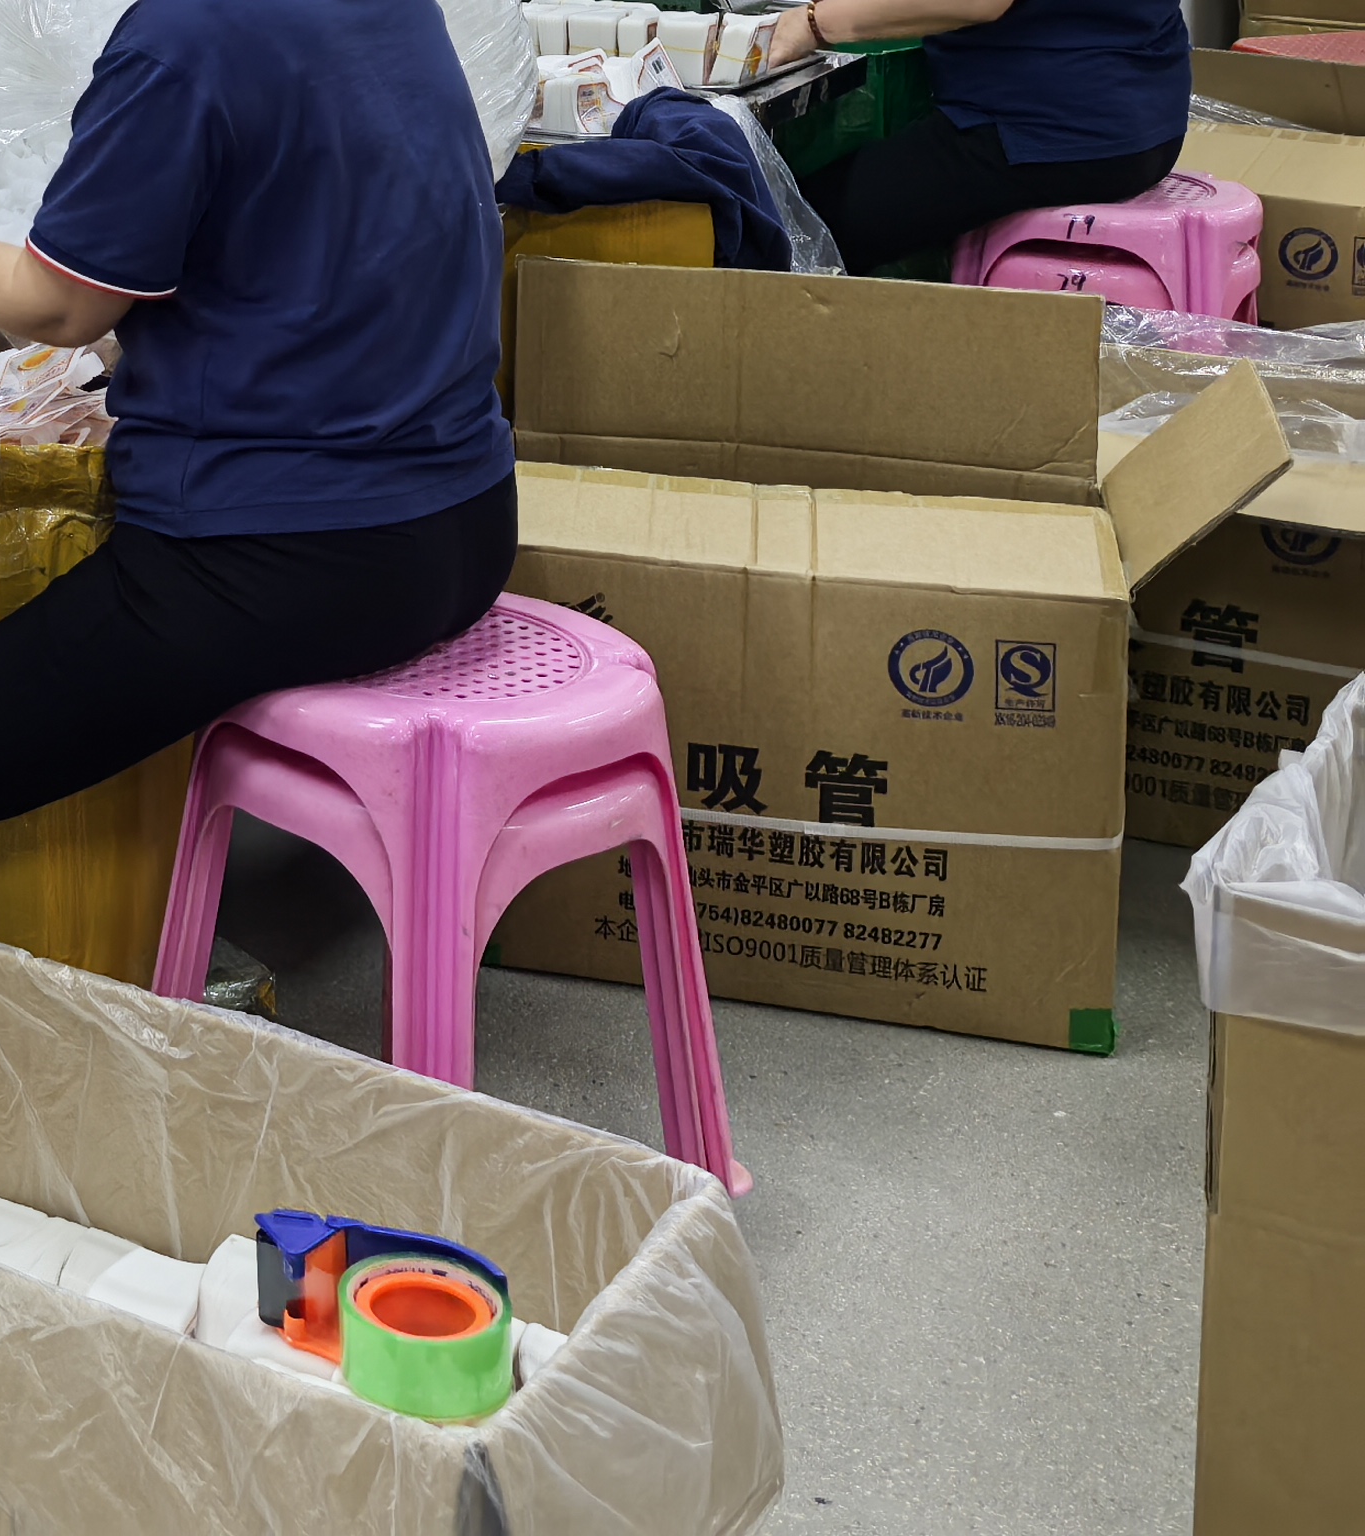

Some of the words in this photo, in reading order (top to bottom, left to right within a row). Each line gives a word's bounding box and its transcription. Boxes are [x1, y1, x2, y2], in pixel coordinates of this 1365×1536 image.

[687, 742, 888, 828] 吸管
[683, 820, 948, 882] 市瑞华塑胶有限公司
[702, 932, 988, 993] ISO9001质量管理体系认证
[843, 923, 942, 951] 82482277
